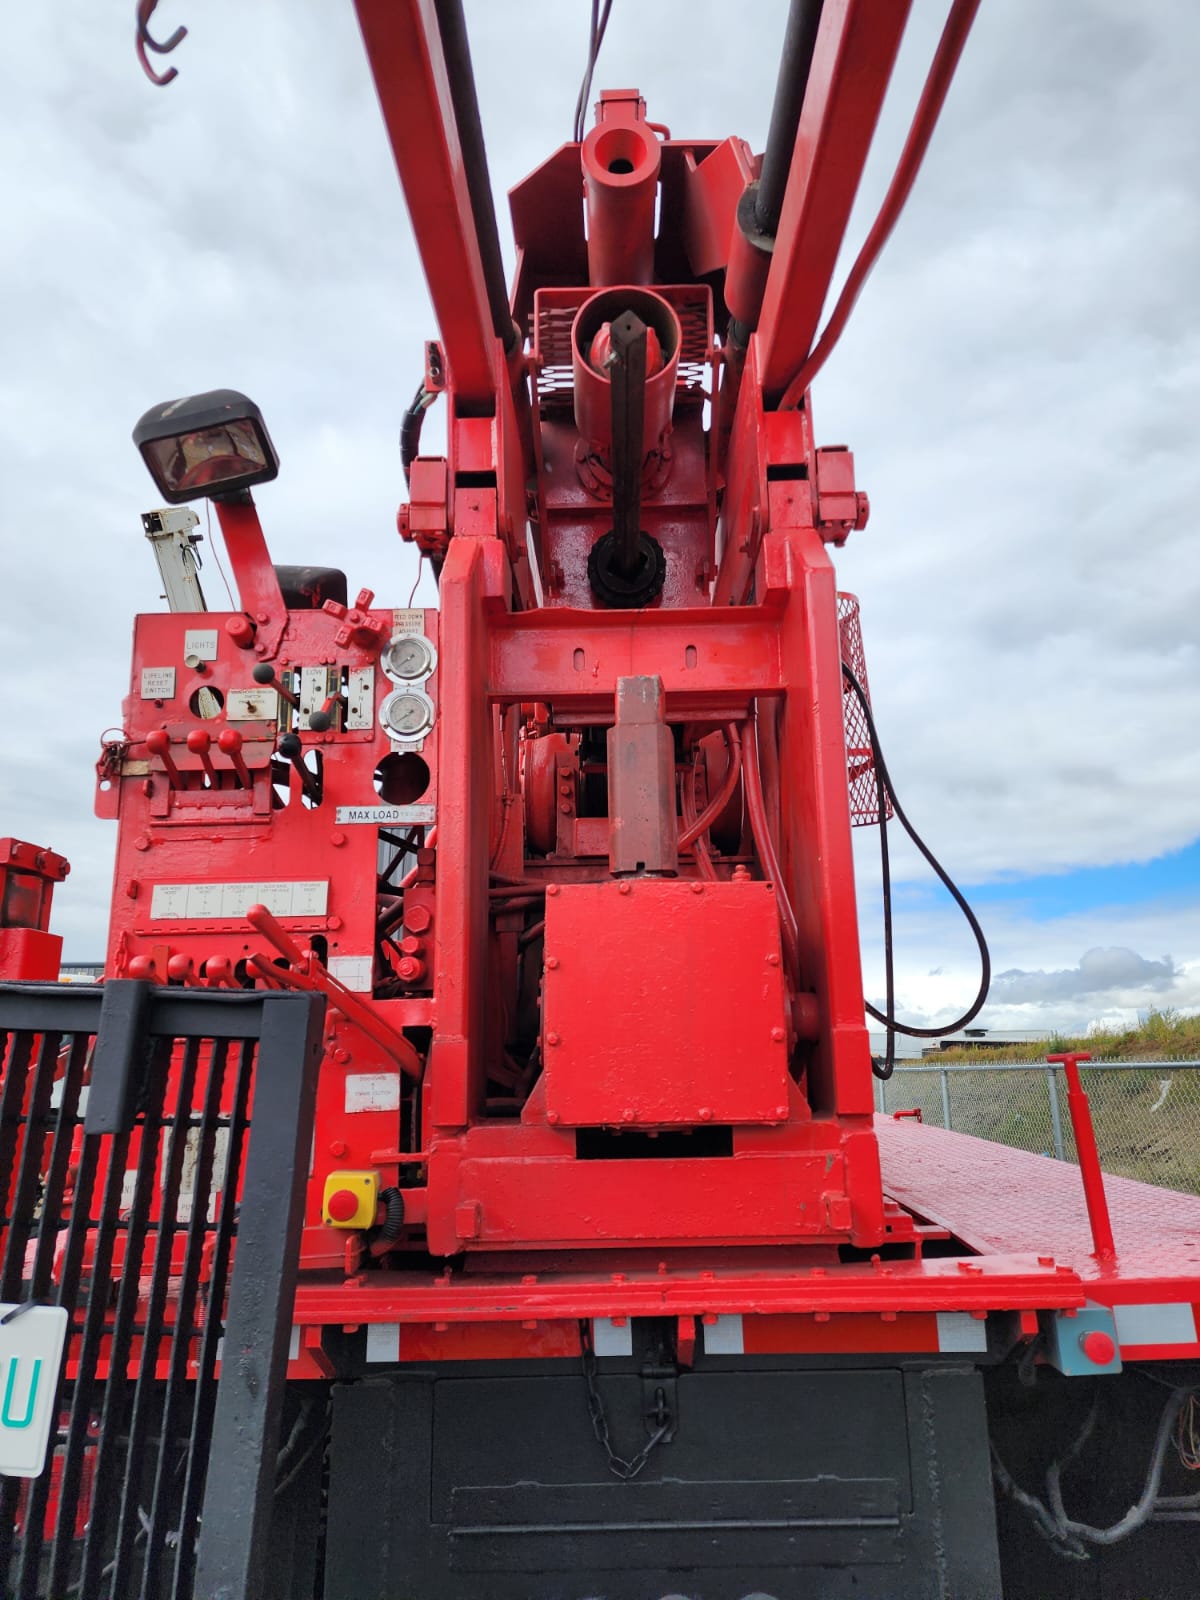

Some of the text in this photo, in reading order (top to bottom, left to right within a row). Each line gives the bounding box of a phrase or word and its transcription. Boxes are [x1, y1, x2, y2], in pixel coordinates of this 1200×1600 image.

[186, 641, 216, 650] LIGHTS
[348, 810, 370, 820] MAX
[373, 810, 400, 820] LOAD
[0, 1357, 42, 1429] U
